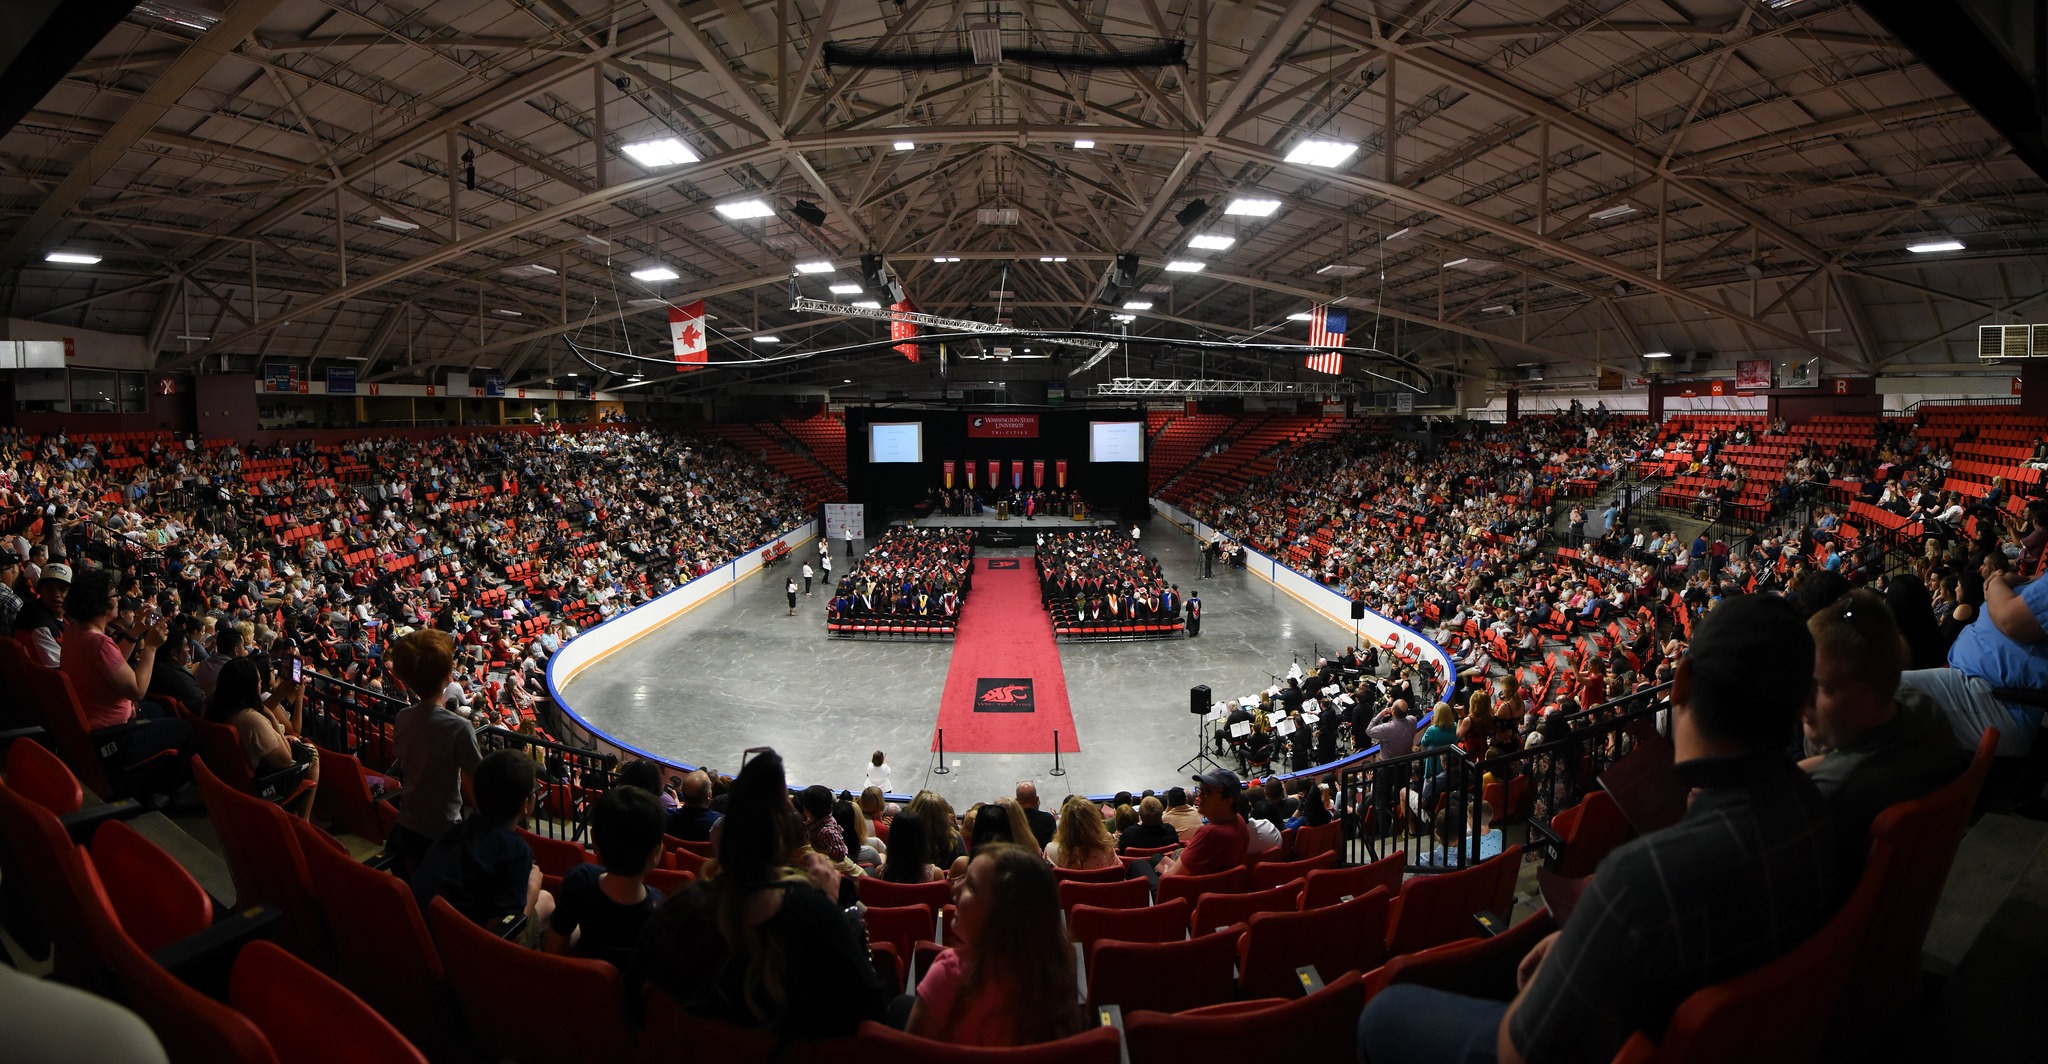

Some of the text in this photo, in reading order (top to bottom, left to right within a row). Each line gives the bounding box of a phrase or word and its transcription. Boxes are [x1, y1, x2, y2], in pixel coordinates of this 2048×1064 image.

[163, 379, 173, 394] X
[371, 384, 378, 394] Y
[1836, 380, 1846, 393] R
